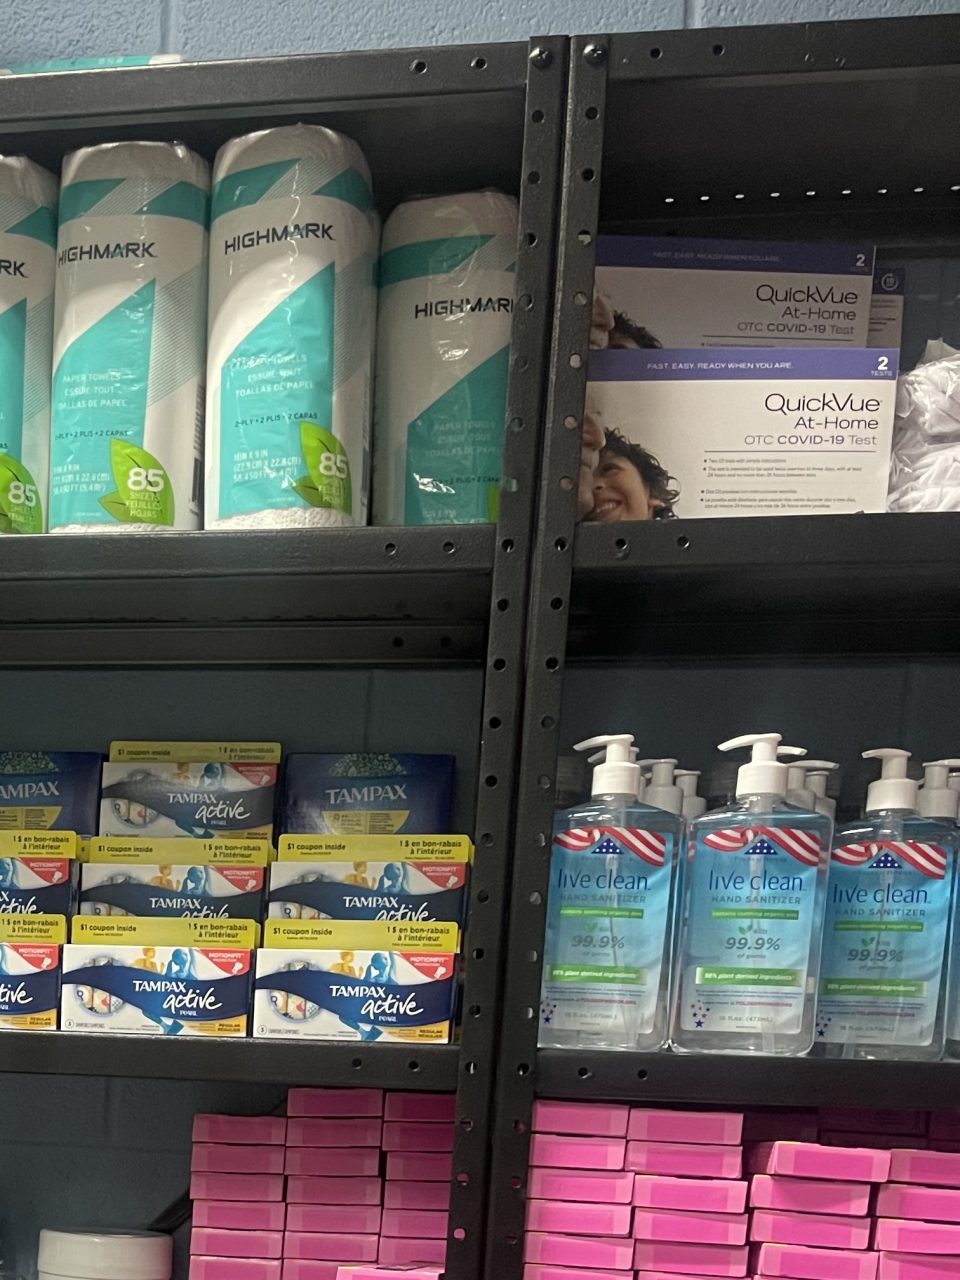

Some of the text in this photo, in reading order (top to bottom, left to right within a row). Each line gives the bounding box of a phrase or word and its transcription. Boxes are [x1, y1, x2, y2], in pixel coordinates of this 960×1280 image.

[224, 223, 335, 255] HIGHMARK
[57, 241, 157, 266] HIGHMARK
[856, 254, 865, 267] 2
[756, 284, 858, 305] QuickVue
[781, 306, 856, 321] At-Home
[737, 322, 854, 335] OTC COVID-19 Test
[877, 356, 888, 370] 2
[765, 393, 881, 415] QuickVue
[794, 416, 878, 430] At-Home
[744, 435, 876, 445] OTC COVID-19 Test
[319, 451, 348, 479] 85
[127, 467, 165, 492] 85
[8, 480, 37, 508] 85
[167, 793, 217, 804] TAMPAX
[325, 784, 407, 804] TAMPAX
[195, 798, 250, 824] active
[558, 868, 648, 890] live clean
[709, 869, 802, 891] live clean
[590, 894, 646, 903] SANITIZER
[745, 896, 801, 904] SANITIZER
[832, 883, 928, 904] live clean
[149, 897, 201, 909] TAMPAX
[343, 896, 398, 908] TAMPAX
[869, 908, 926, 917] SANITIZER
[23, 918, 59, 927] bon-rabais
[89, 924, 114, 933] coupon
[117, 924, 137, 932] inside
[210, 923, 247, 931] bon-rabais
[205, 931, 239, 939] l'intérieur
[282, 929, 309, 937] coupon
[311, 928, 333, 936] inside
[410, 926, 450, 934] bon-rabais
[404, 934, 440, 942] l'intérieur
[571, 935, 625, 949] 99.9%
[724, 937, 780, 950] 99.9%
[846, 949, 903, 962] 99.9%
[132, 980, 187, 993] TAMPAX
[329, 985, 386, 998] TAMPAX
[162, 987, 223, 1014] active
[360, 992, 423, 1020] active
